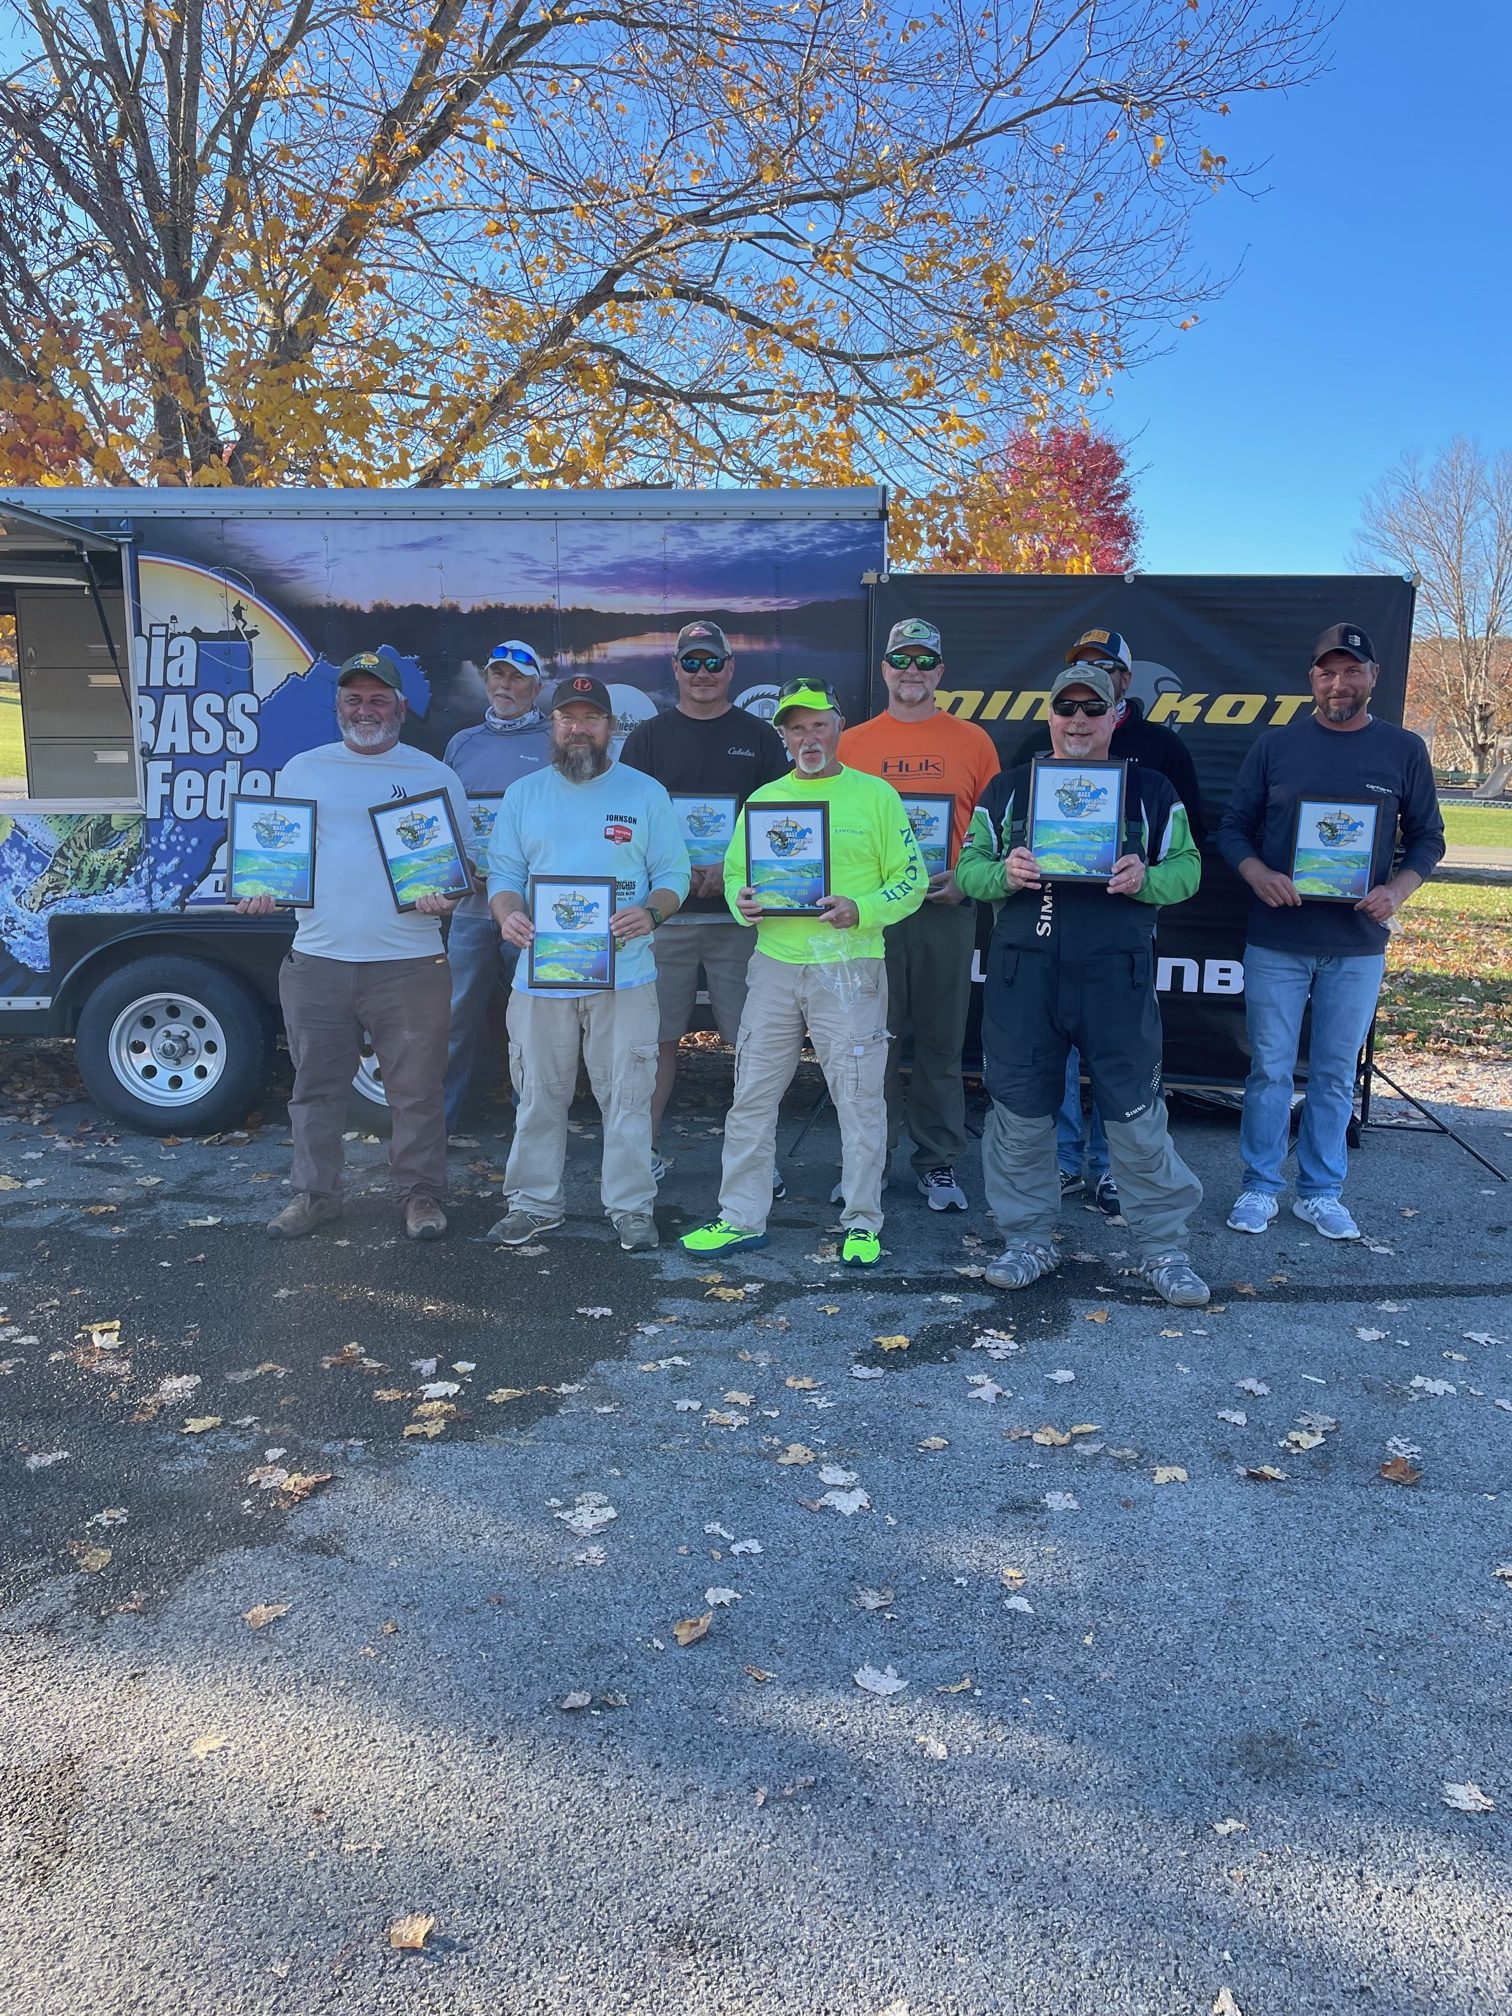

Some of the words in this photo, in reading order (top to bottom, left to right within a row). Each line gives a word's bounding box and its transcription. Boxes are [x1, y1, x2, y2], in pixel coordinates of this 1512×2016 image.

[934, 690, 1052, 720] MIN
[1147, 692, 1318, 725] KOT
[606, 814, 638, 825] JOHNSON
